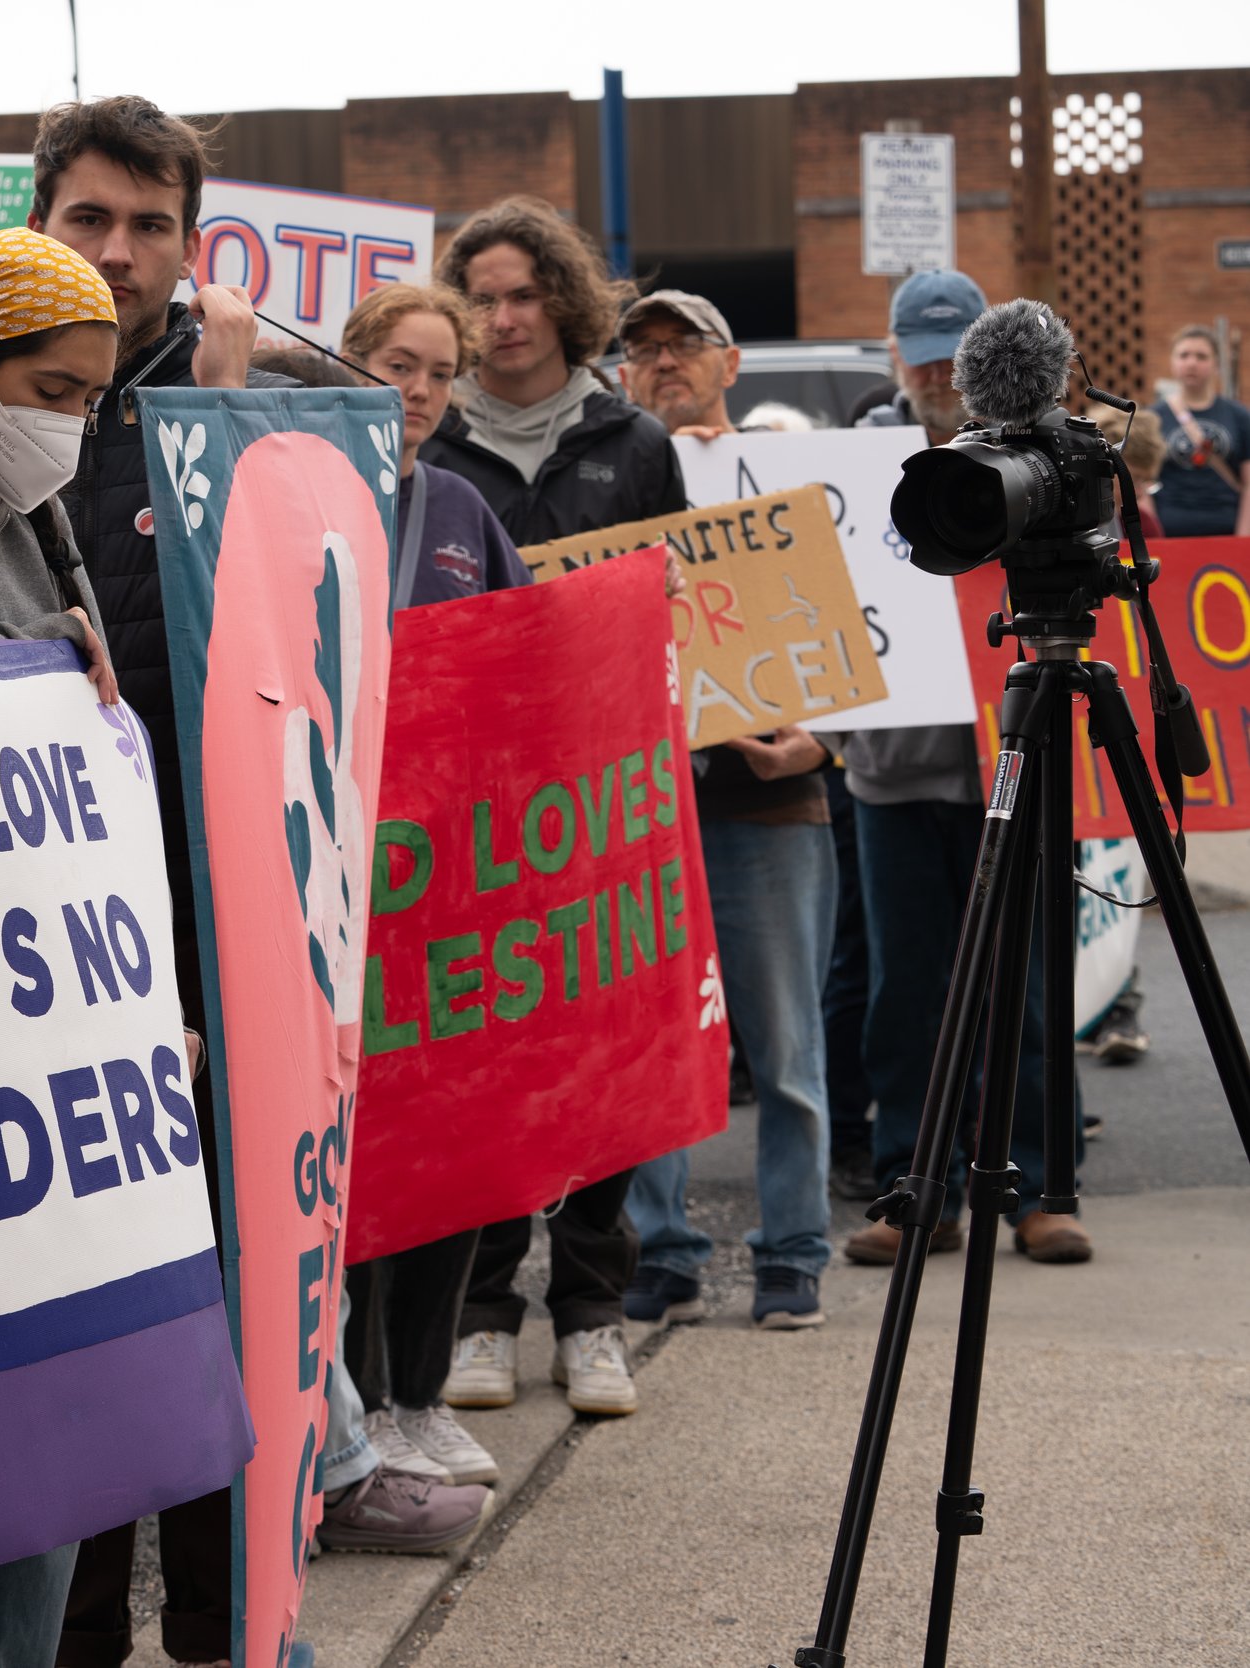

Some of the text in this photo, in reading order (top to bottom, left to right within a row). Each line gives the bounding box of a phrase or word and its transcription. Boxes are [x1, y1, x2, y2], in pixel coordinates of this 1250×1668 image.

[1004, 425, 1032, 436] Nikon
[472, 738, 677, 893] LOVES
[991, 755, 1008, 808] Manfrotto
[61, 894, 153, 1006] NO
